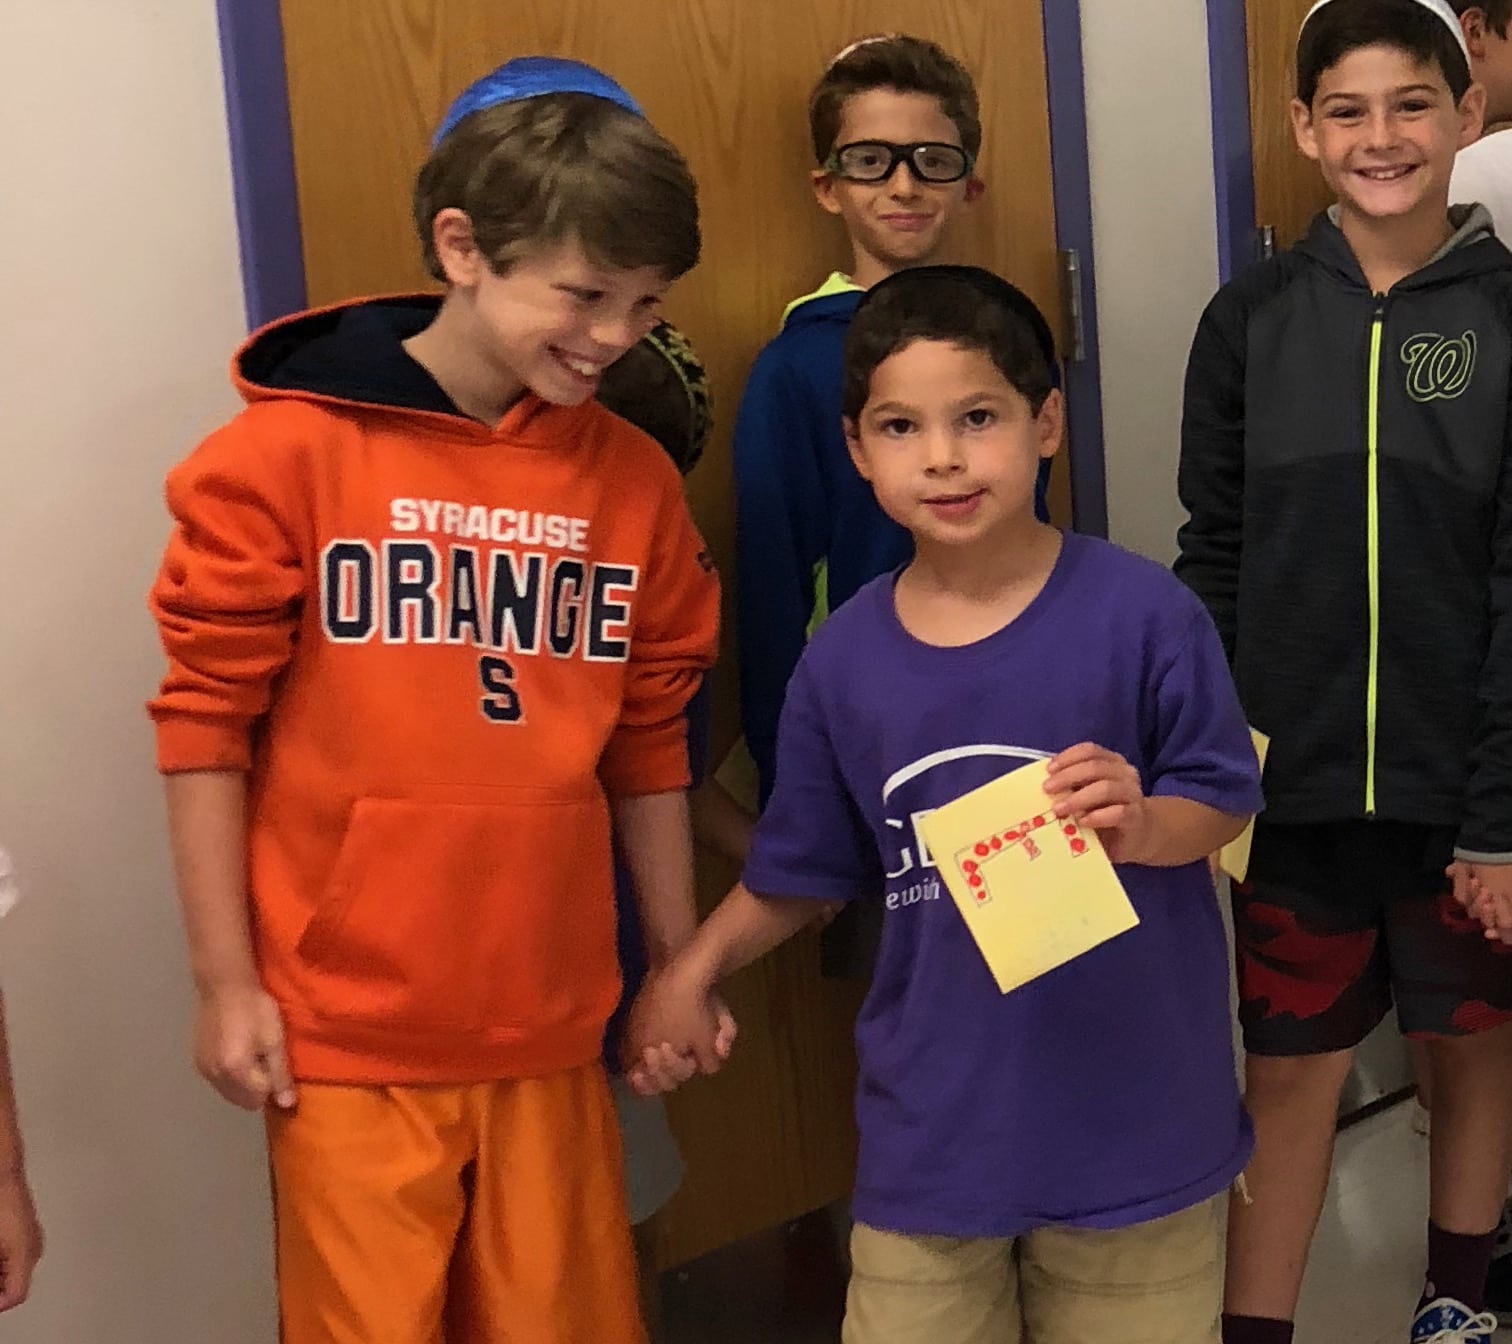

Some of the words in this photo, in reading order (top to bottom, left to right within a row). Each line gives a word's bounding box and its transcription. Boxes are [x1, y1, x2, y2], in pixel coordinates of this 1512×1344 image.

[389, 498, 591, 552] SYRACUSE
[320, 538, 640, 664] ORANGE
[478, 653, 527, 726] S
